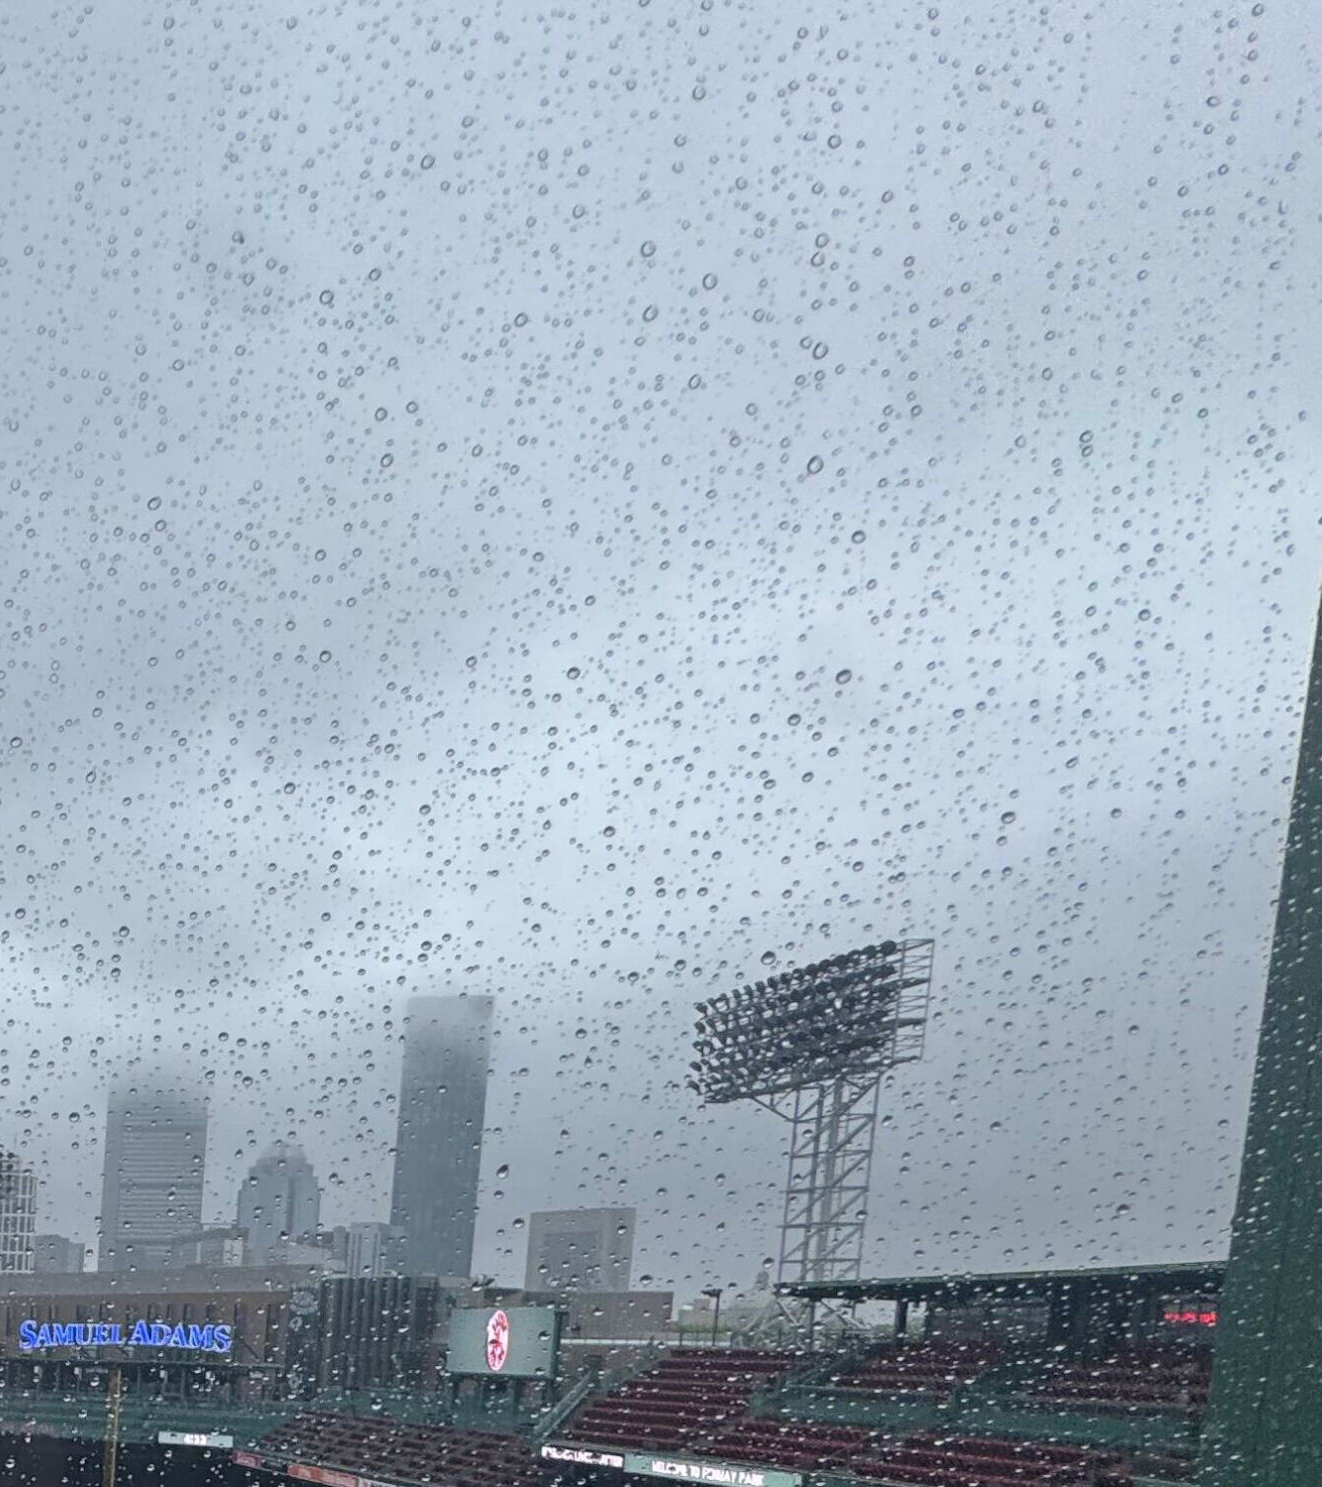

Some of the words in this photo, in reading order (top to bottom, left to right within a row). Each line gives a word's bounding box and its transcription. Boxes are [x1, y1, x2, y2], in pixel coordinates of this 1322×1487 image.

[18, 1319, 123, 1350] SAMUEL
[128, 1319, 234, 1353] ADAMS
[652, 1460, 688, 1477] WELCOME
[689, 1464, 701, 1478] TO
[739, 1471, 765, 1487] PARK
